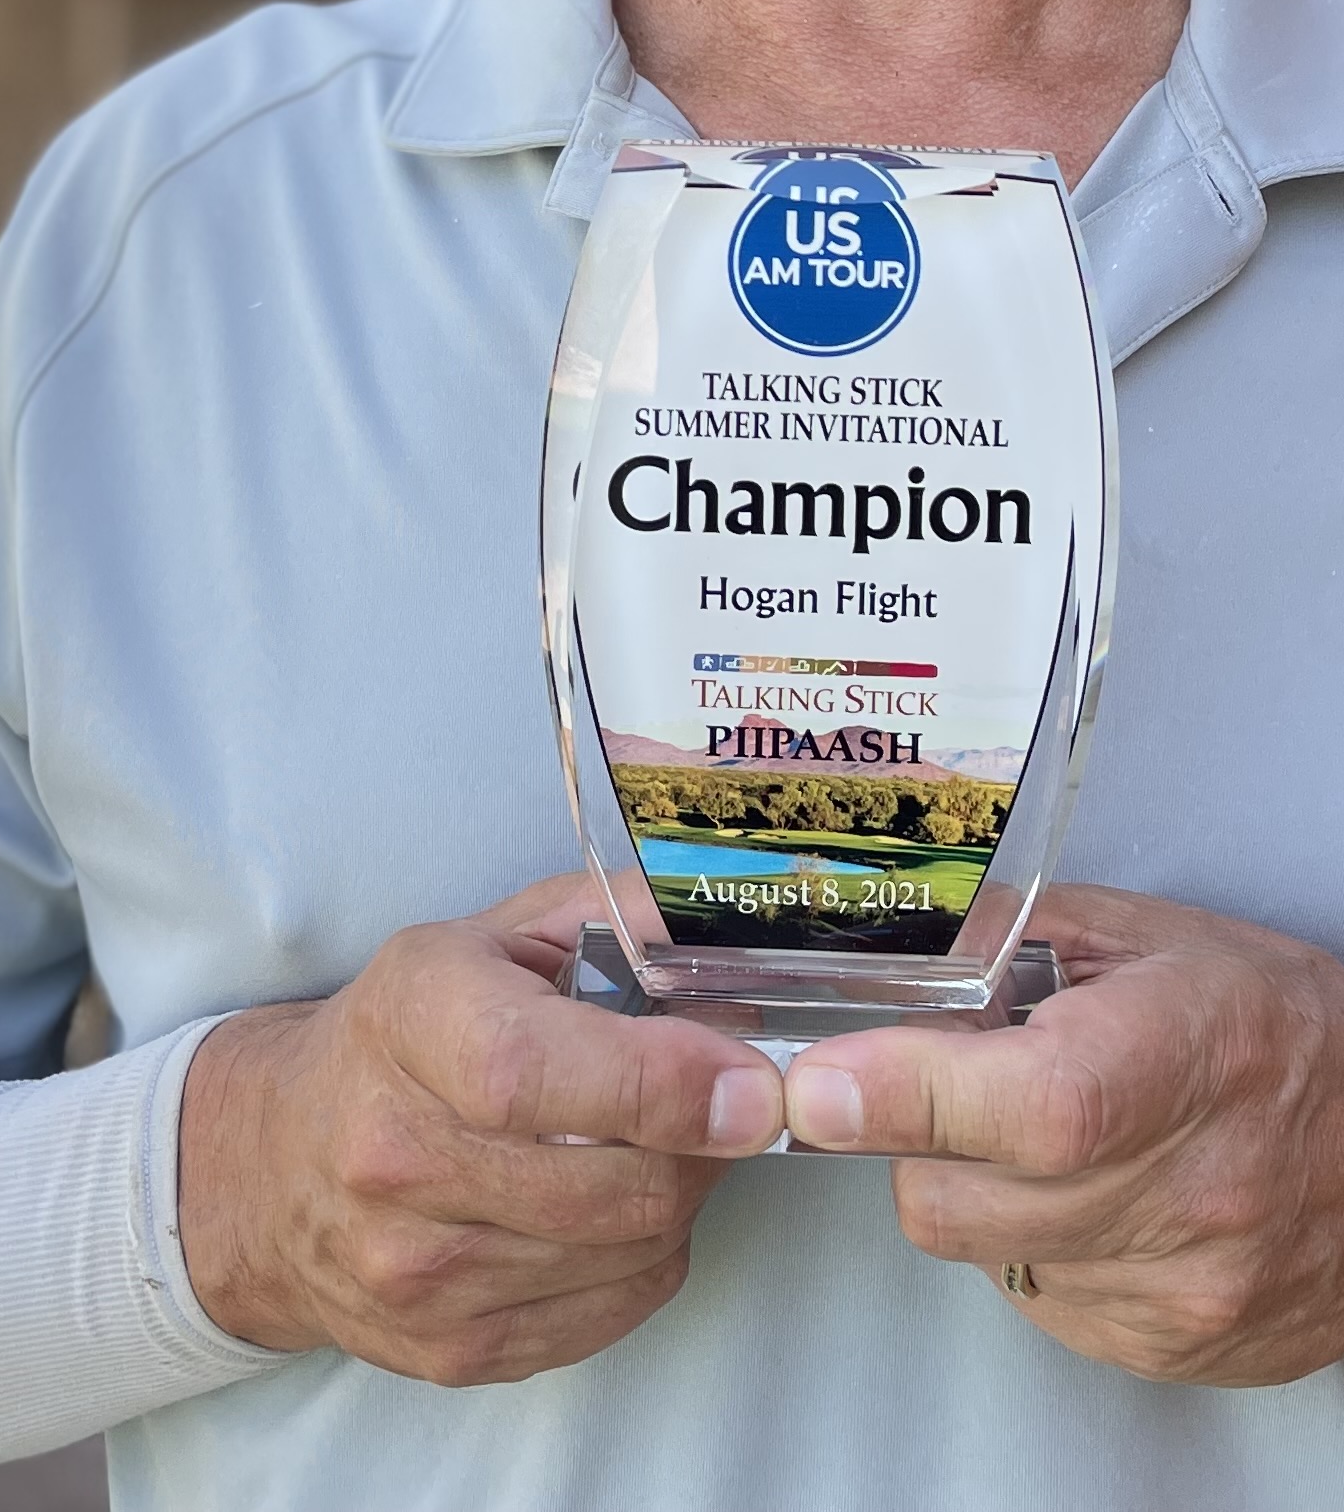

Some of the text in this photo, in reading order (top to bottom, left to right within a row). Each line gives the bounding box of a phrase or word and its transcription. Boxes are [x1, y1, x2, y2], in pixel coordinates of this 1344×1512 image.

[743, 257, 906, 291] AM TOUR
[702, 372, 944, 408] TALKING STICK
[633, 407, 1010, 448] SUMMER INVITATIONAL
[607, 454, 1032, 554] Champion
[699, 575, 939, 624] Hogan Flight
[691, 678, 940, 717] TALKING STICK
[705, 724, 924, 765] PIIPAASH
[687, 872, 935, 914] August 8, 2021
